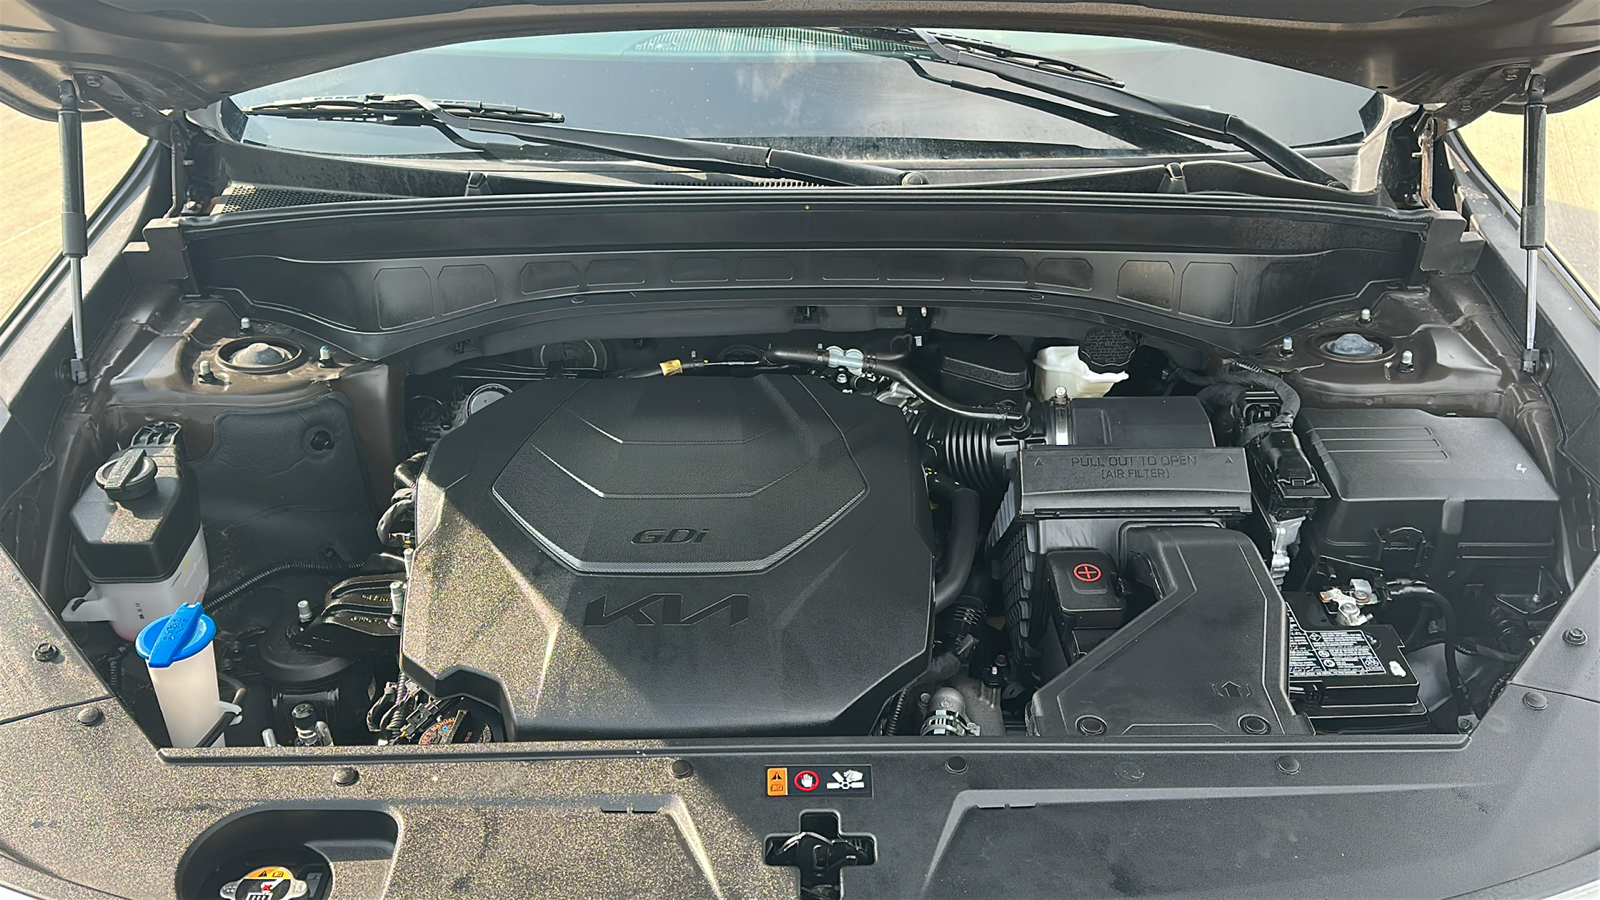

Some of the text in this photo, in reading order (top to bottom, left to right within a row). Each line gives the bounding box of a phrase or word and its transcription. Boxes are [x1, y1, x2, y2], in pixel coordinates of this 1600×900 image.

[1071, 455, 1197, 467] PULL OUT TO OPEN
[630, 528, 710, 545] GDi
[583, 592, 751, 628] KIA
